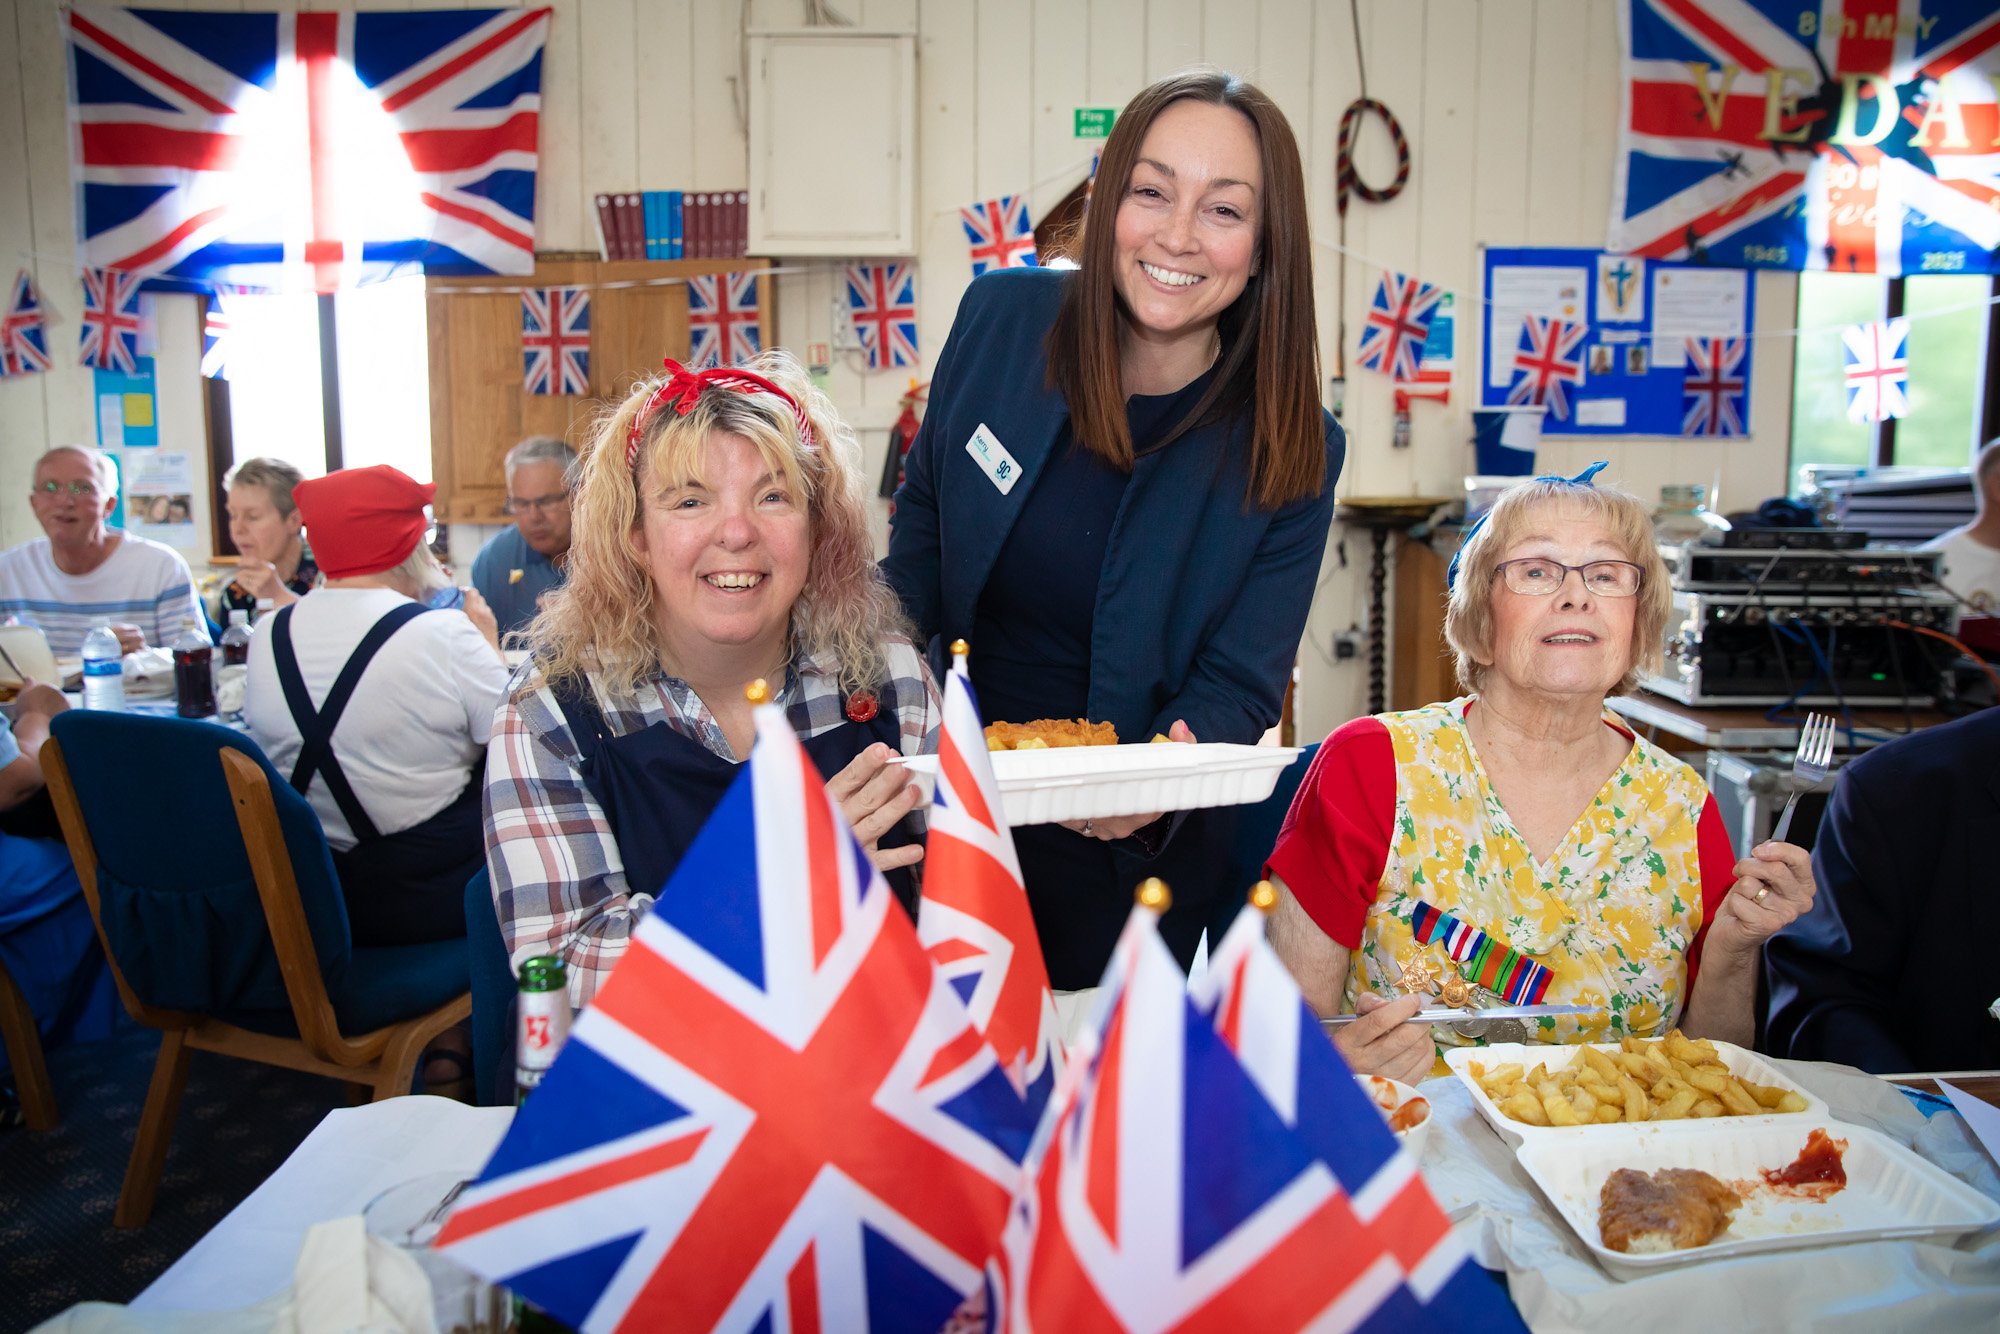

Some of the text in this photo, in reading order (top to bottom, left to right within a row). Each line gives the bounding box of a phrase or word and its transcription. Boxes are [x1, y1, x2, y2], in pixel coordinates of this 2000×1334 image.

[1863, 13, 1940, 40] MAY
[1079, 110, 1105, 123] Fire
[1828, 72, 2000, 147] DA
[976, 433, 989, 453] Kerry
